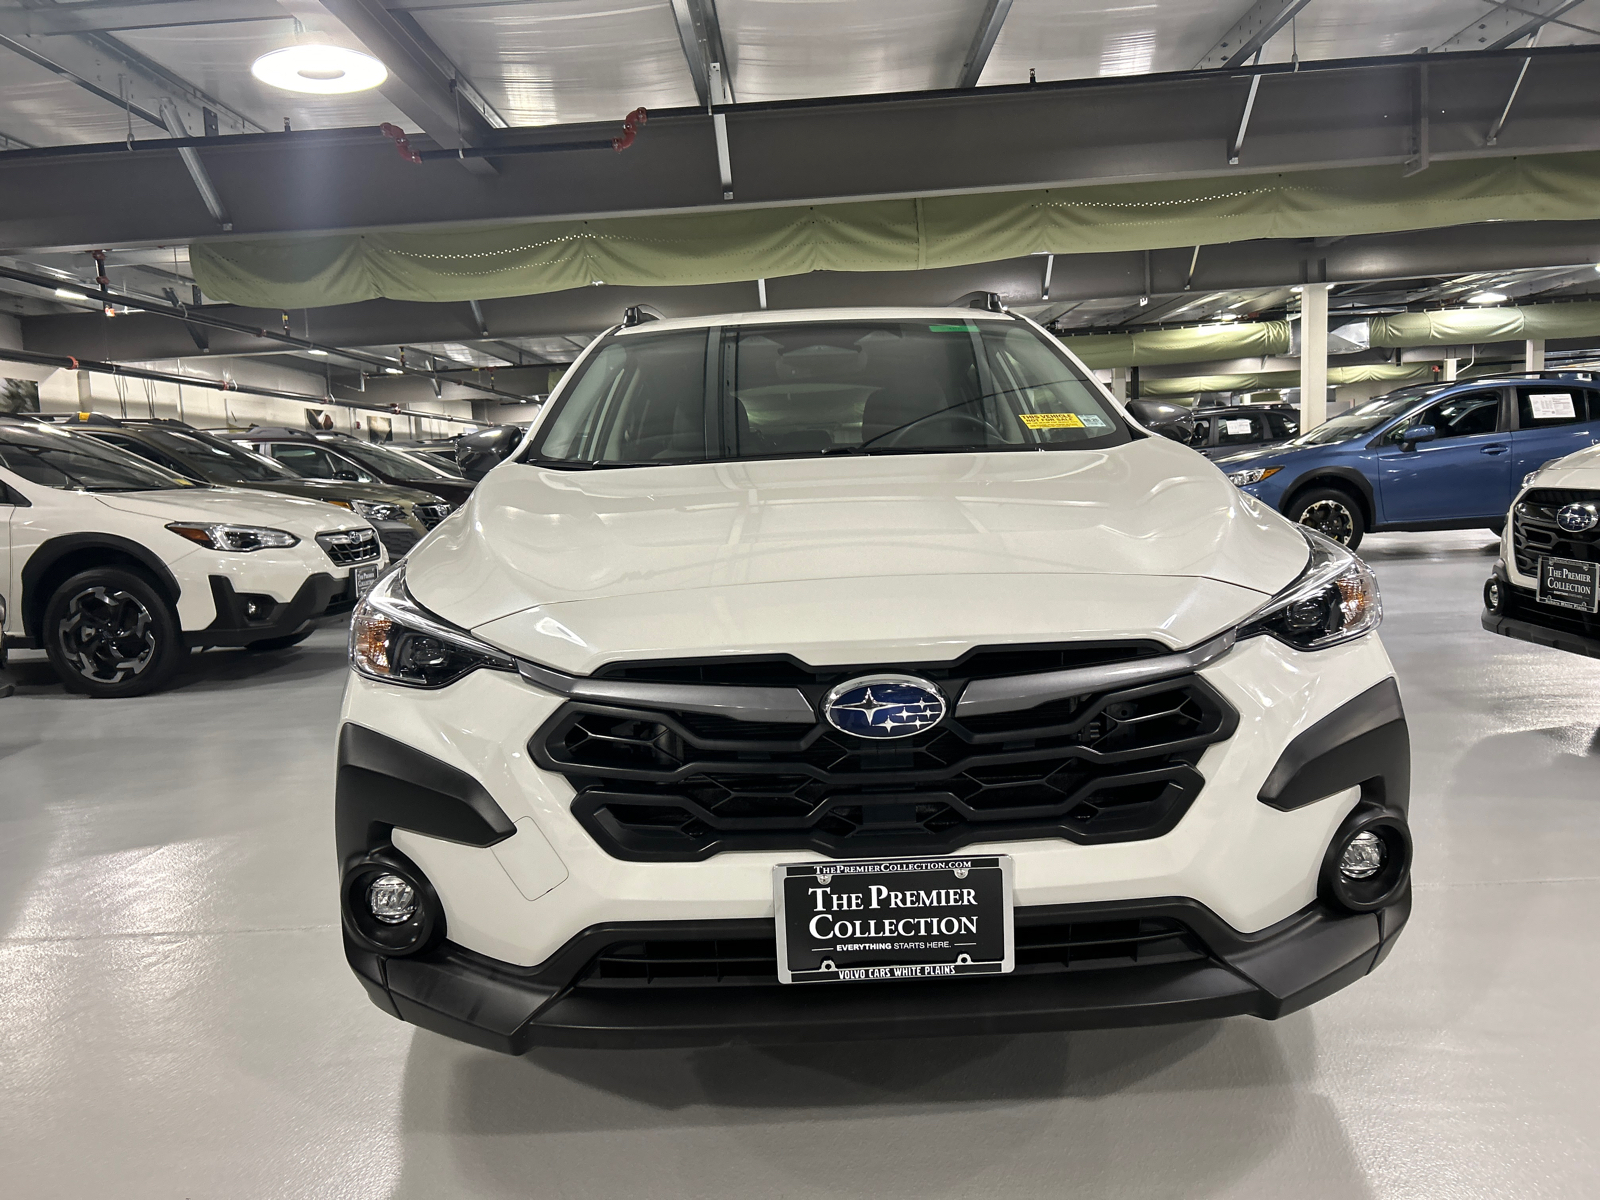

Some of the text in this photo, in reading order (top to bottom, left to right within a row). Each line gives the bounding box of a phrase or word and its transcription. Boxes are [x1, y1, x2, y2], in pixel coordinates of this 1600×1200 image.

[1548, 566, 1591, 582] THE PREMIER
[1548, 577, 1590, 594] COLLECTION
[808, 884, 978, 912] THE PREMIER
[808, 913, 979, 940] COLLECTION
[836, 941, 952, 952] EVERYTHING STARTS HERE.
[838, 965, 956, 980] VOLVO CARS WHITE PLAINS
